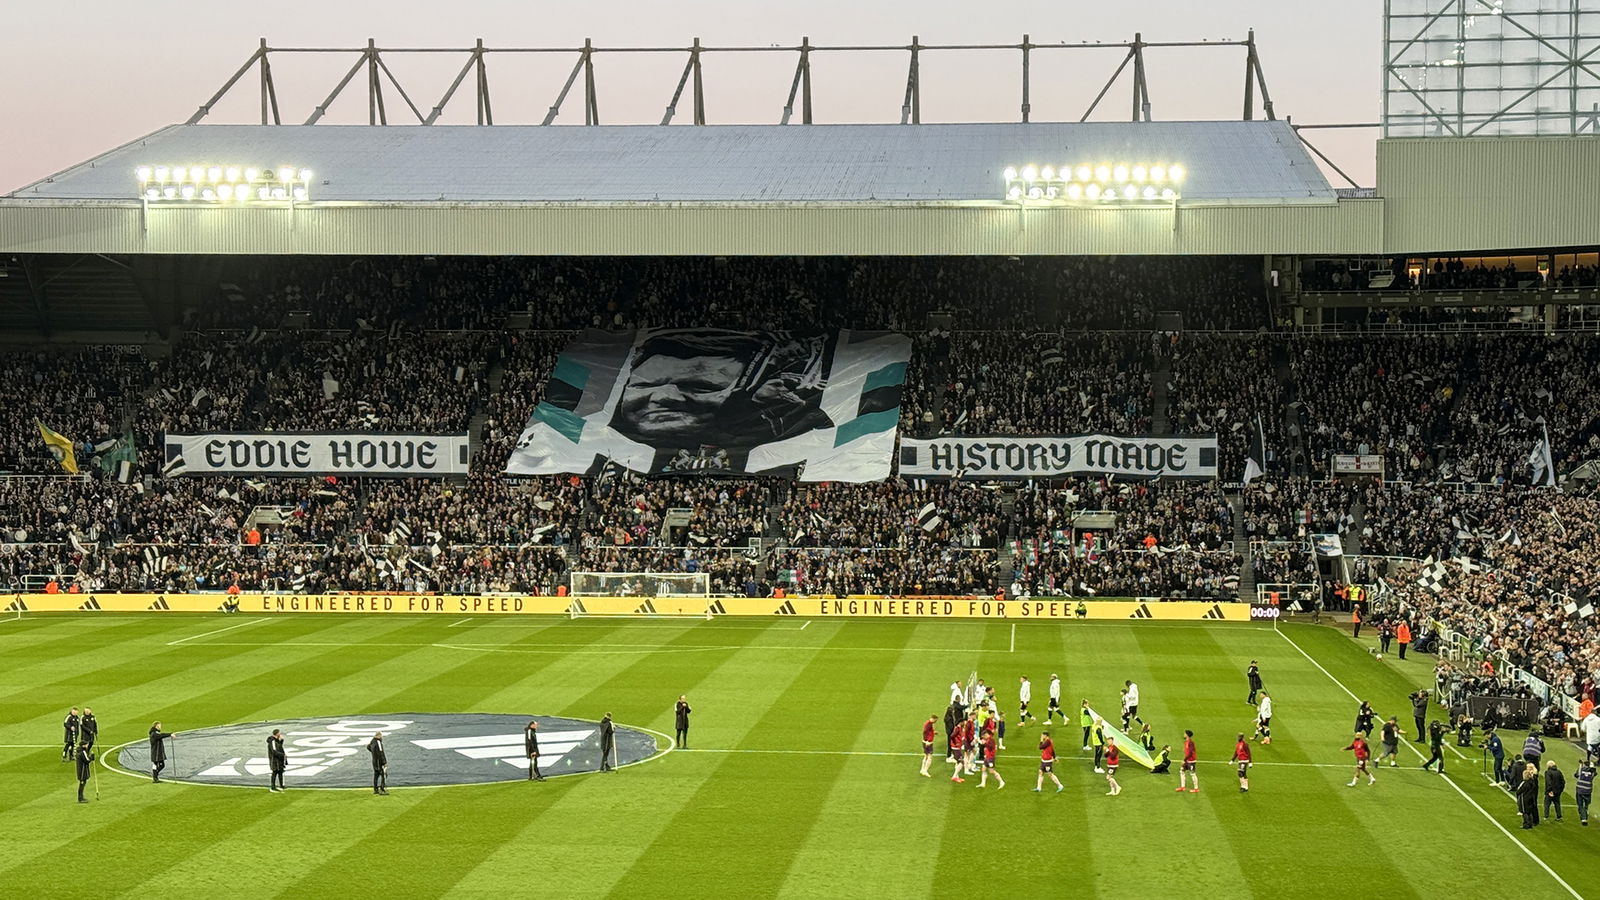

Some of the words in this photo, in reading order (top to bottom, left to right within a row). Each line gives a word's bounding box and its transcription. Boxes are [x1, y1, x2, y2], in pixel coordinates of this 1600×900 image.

[86, 344, 103, 352] THE
[104, 344, 142, 354] CORNER
[205, 439, 312, 469] EDDIE
[328, 439, 438, 470] HOWE
[929, 442, 1071, 472] HISTORY
[1084, 440, 1188, 472] MADE
[263, 596, 393, 611] ENGINEERED
[408, 597, 444, 611] FOR
[459, 597, 524, 612] SPEED
[820, 600, 953, 615] ENGINEERED
[969, 601, 1005, 615] FOR
[1021, 602, 1072, 617] SPEE
[1250, 607, 1280, 618] 00:00
